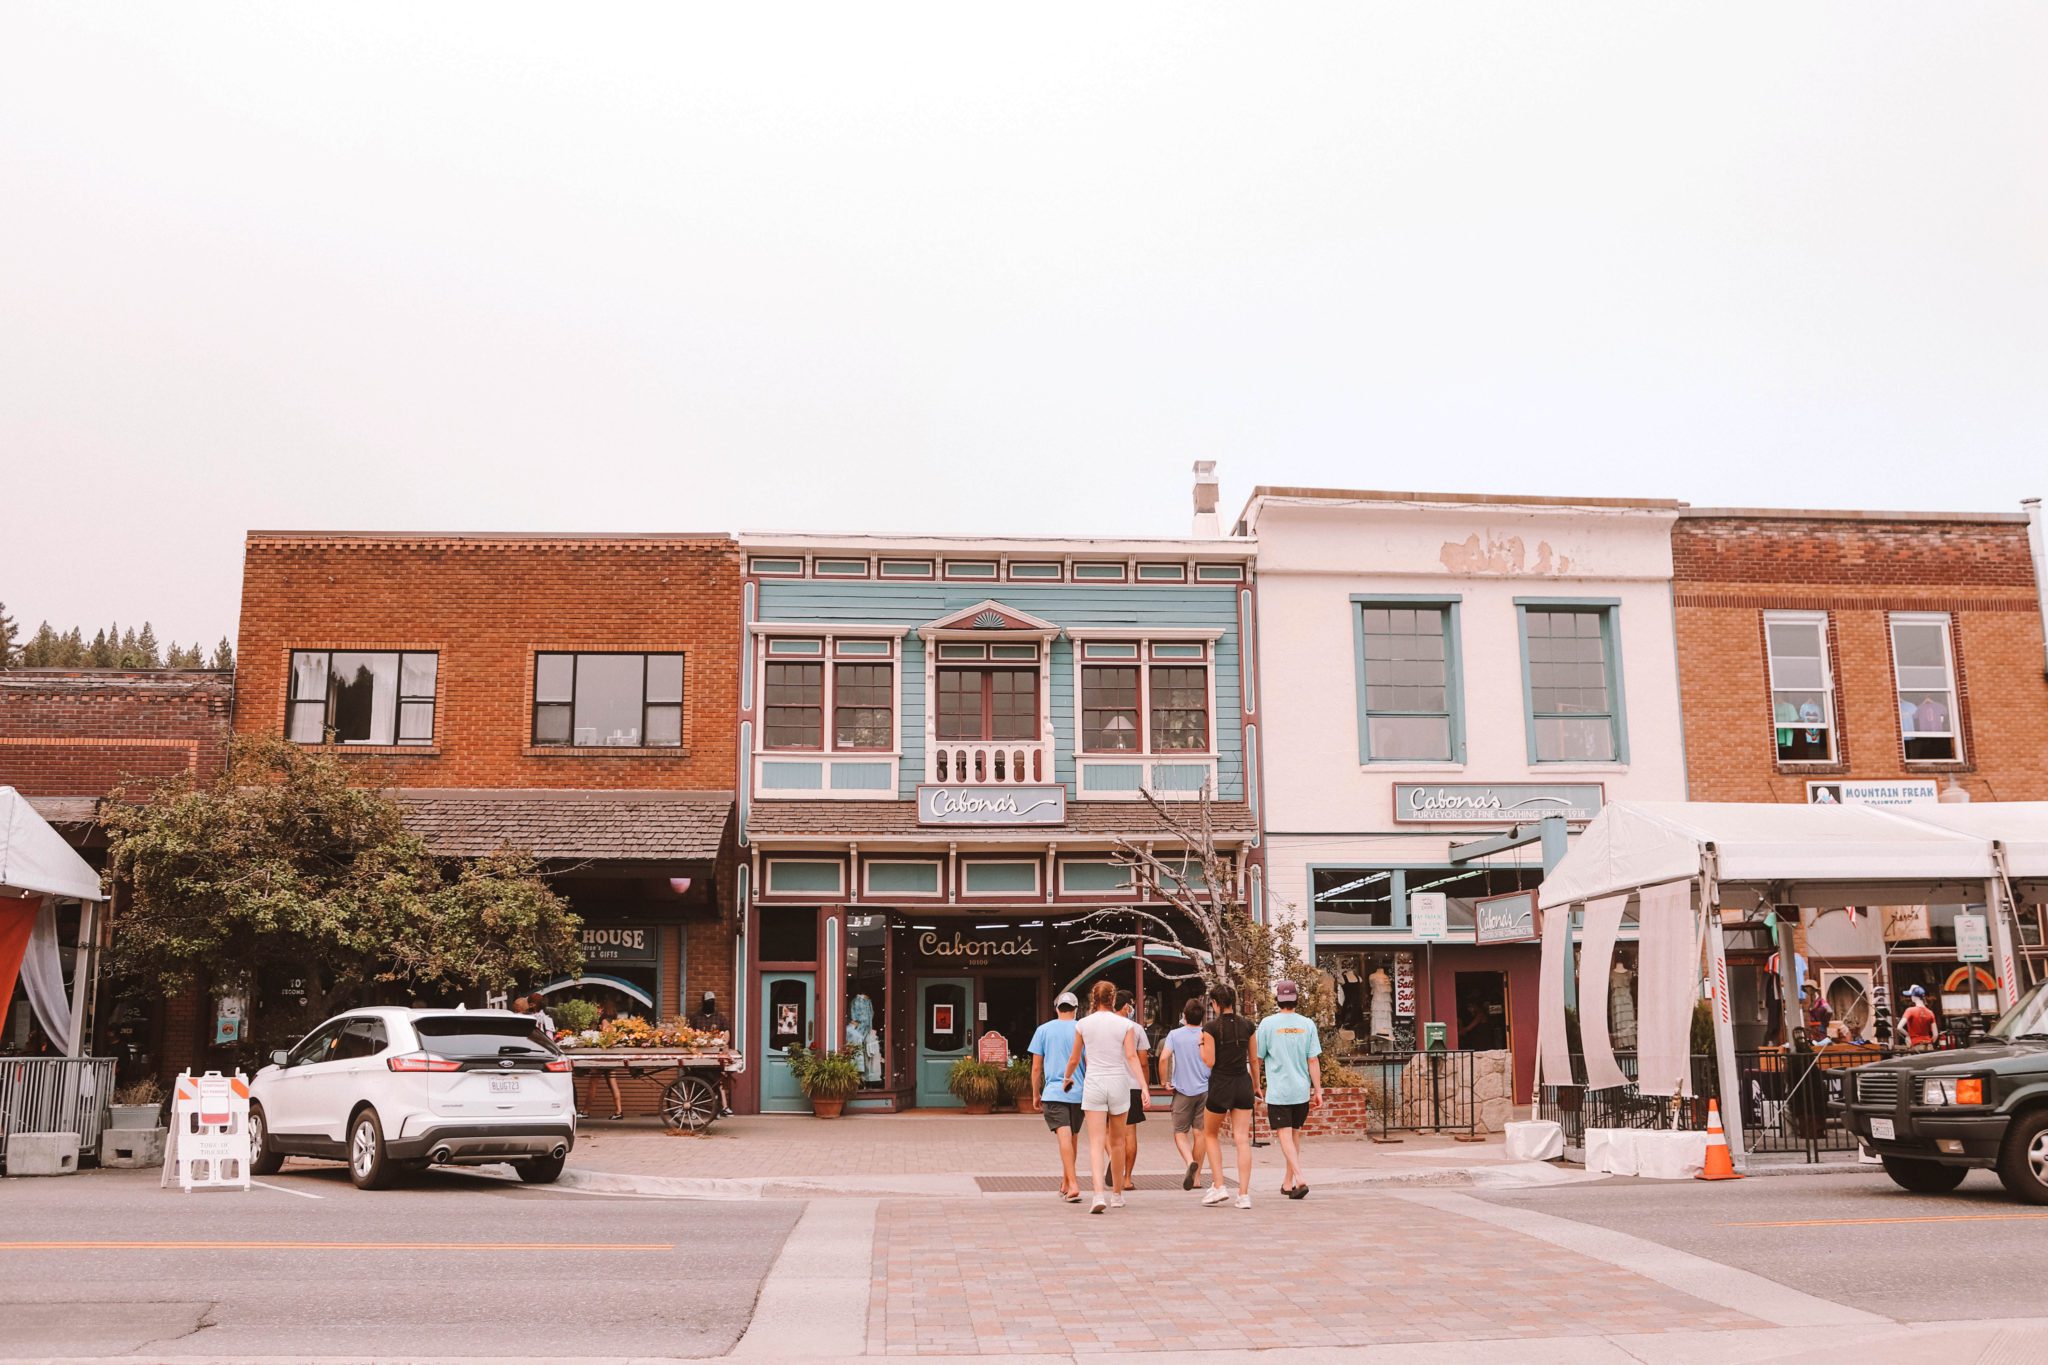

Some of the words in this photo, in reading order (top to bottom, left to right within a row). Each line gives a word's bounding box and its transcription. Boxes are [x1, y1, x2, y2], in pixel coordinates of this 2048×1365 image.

[1410, 787, 1572, 811] Cabona's
[1846, 787, 1898, 798] MOUNTAIN
[1902, 787, 1934, 797] FREAK
[931, 789, 1056, 817] Cabona's
[1413, 810, 1462, 818] PURVEYORS
[1464, 810, 1477, 818] OF
[1478, 810, 1495, 818] FINE
[1498, 810, 1539, 818] CLOTHING
[1541, 810, 1565, 818] SINCE
[1567, 810, 1586, 818] 1918
[1479, 907, 1531, 932] Cabona's
[583, 930, 644, 949] HOUSE
[919, 931, 1039, 956] Cabona's
[1397, 978, 1414, 988] Sale
[1398, 990, 1414, 1000] Sale
[1398, 1002, 1415, 1012] Sale
